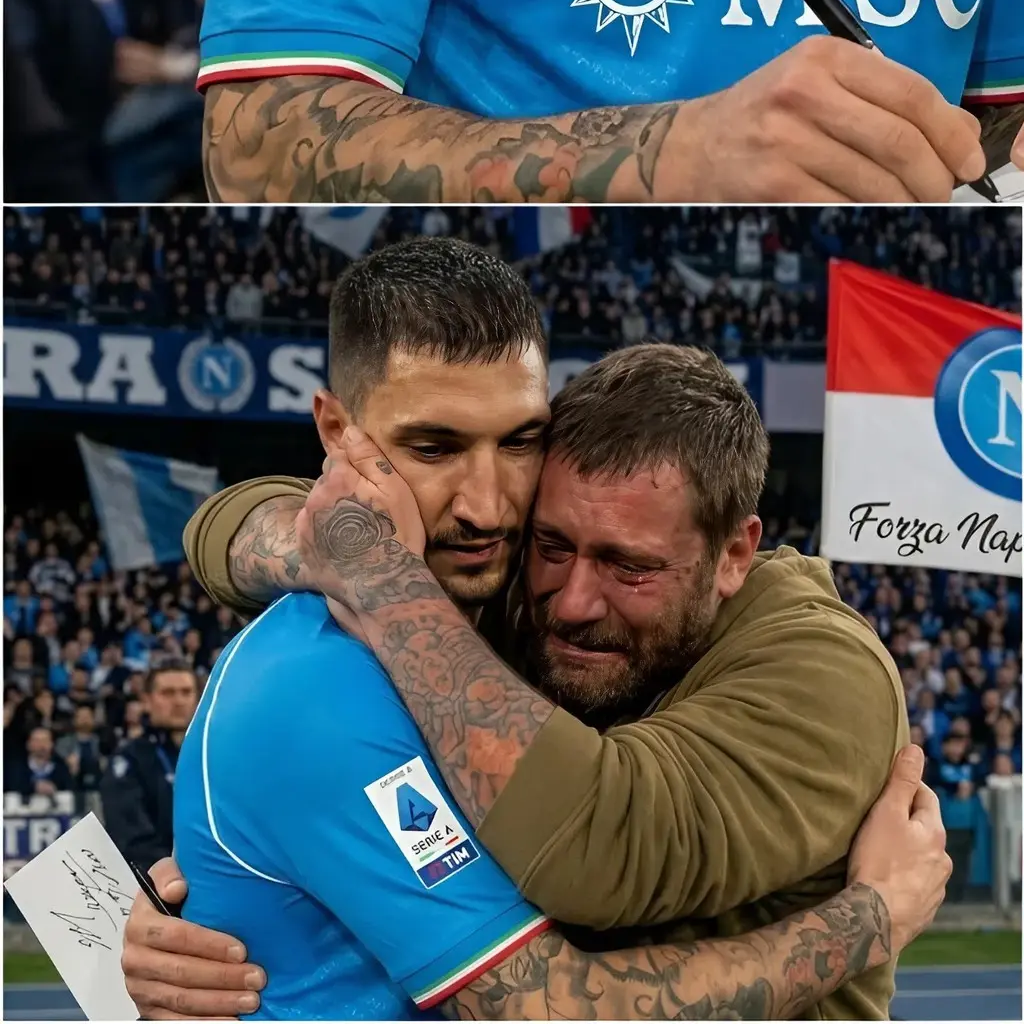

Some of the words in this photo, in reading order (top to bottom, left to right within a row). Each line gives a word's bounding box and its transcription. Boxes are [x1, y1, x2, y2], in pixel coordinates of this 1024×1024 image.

[3, 329, 166, 405] RA
[850, 502, 950, 556] Forza
[442, 846, 470, 869] TIM
